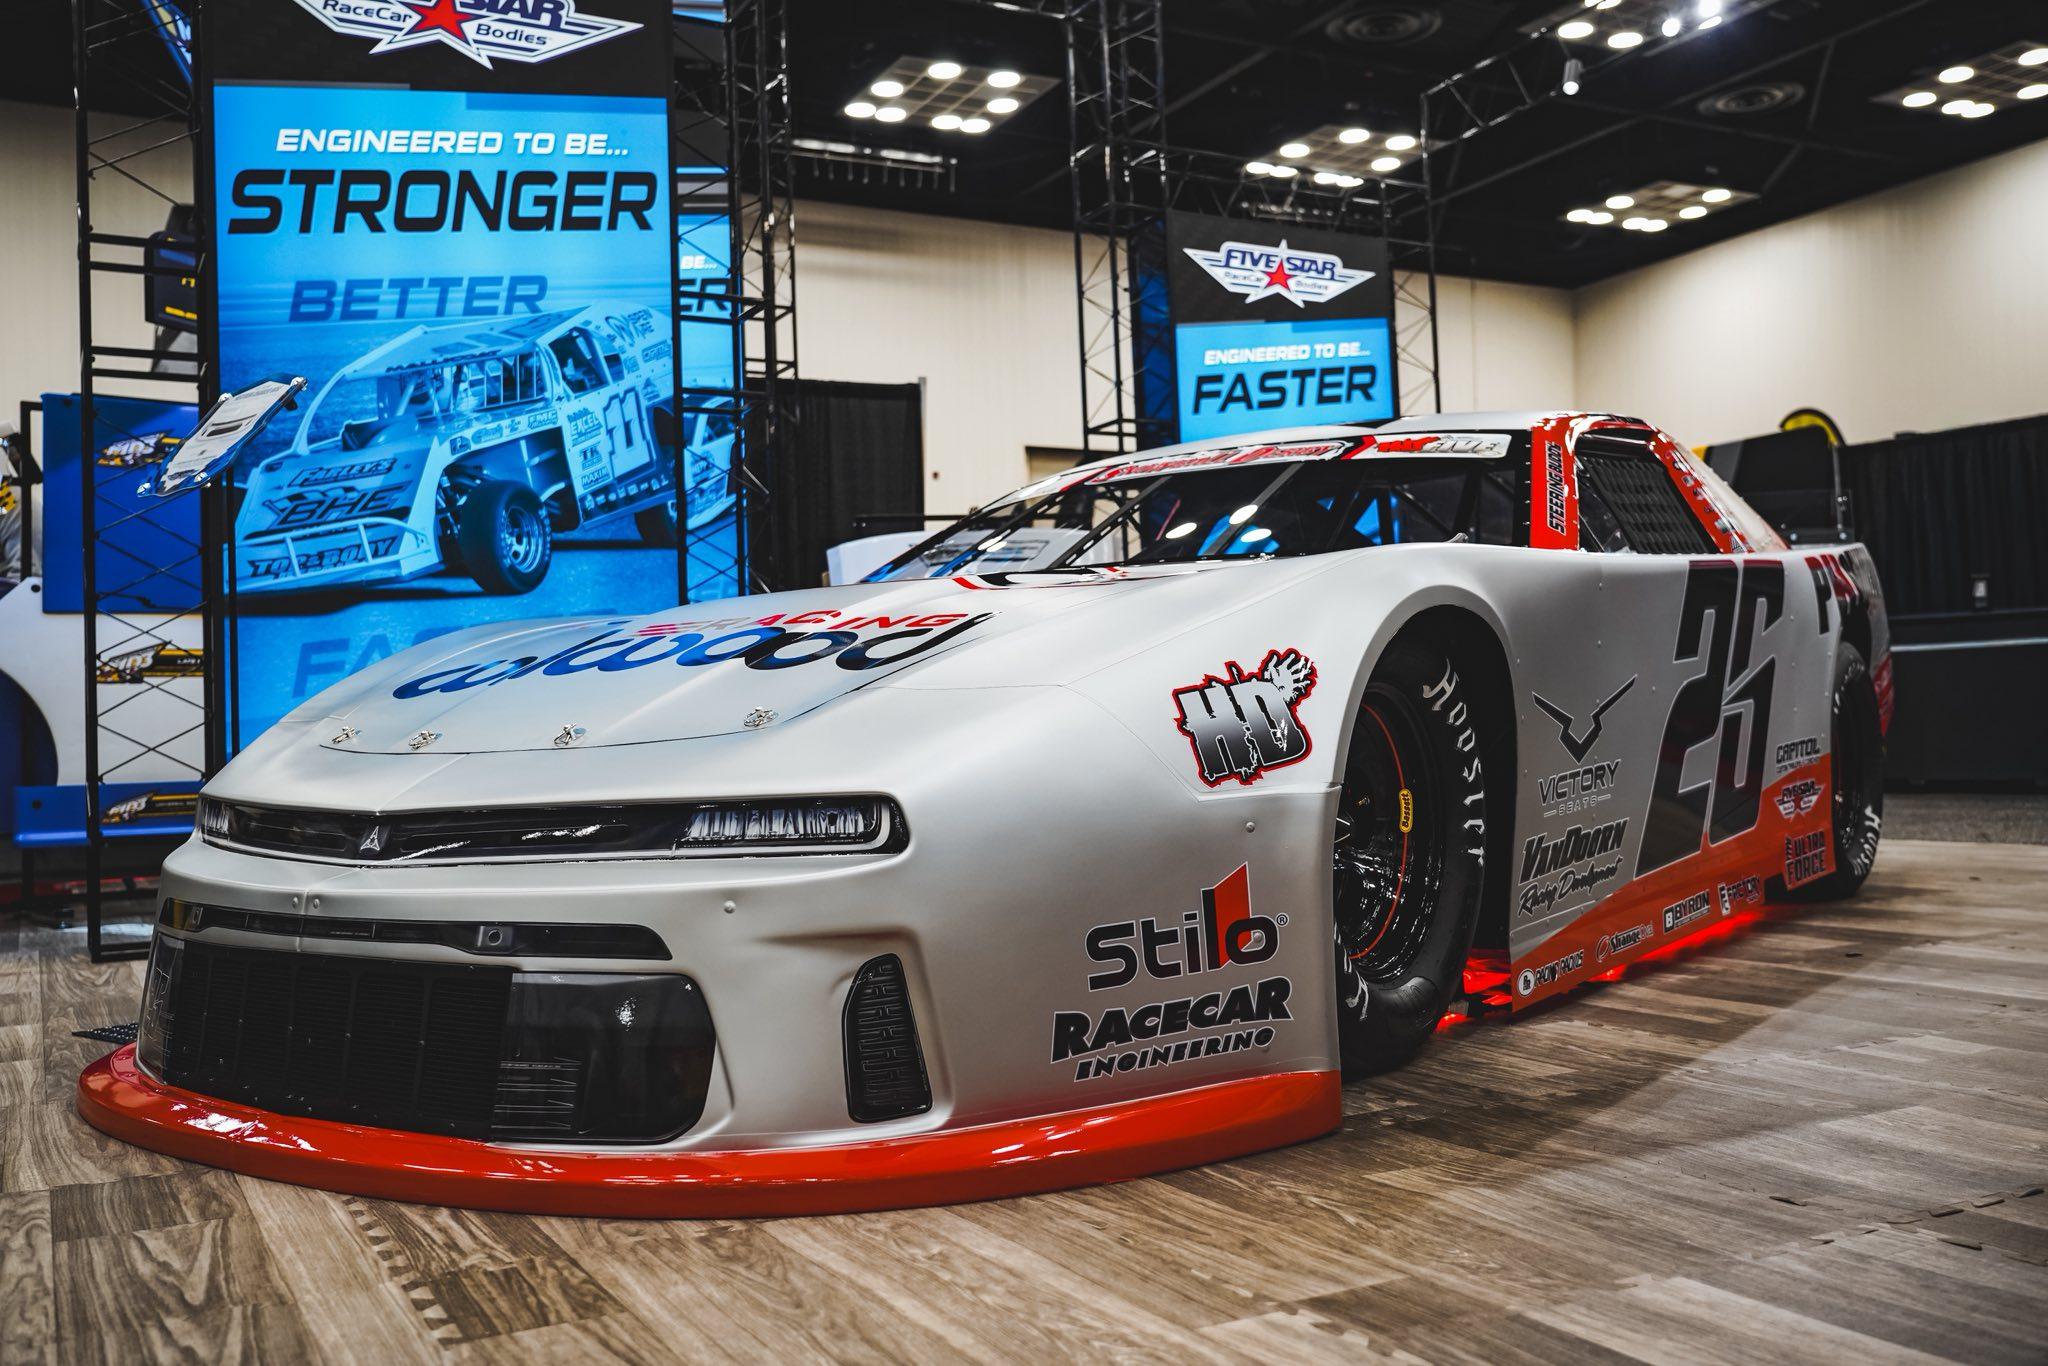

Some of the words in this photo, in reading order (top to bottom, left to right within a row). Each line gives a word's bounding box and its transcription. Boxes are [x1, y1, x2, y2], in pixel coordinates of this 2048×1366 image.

[323, 0, 413, 23] RaceCar
[476, 23, 547, 46] Bodies
[276, 128, 502, 154] ENGINEERED
[513, 131, 554, 155] TO
[564, 132, 630, 156] BE...
[227, 168, 658, 235] STRONGER
[1224, 249, 1280, 268] FIVE
[1285, 256, 1336, 281] STAR
[288, 275, 548, 323] BETTER
[1203, 344, 1311, 366] ENGINEERED
[1314, 343, 1335, 359] TO
[1192, 365, 1377, 415] FASTER
[1546, 471, 1566, 536] STEERING
[1636, 558, 1785, 878] 26
[1776, 737, 1821, 764] CAPITOL
[1538, 759, 1621, 806] VICTORY
[1400, 792, 1411, 829] Bassett
[1558, 795, 1600, 816] SEATS
[1794, 831, 1825, 857] ULTRA
[1787, 851, 1825, 884] FORCE
[1518, 882, 1559, 917] Racing
[1675, 890, 1710, 920] BYRON
[1051, 976, 1294, 1064] RACECAR
[1074, 1026, 1276, 1082] ENGINEERING
